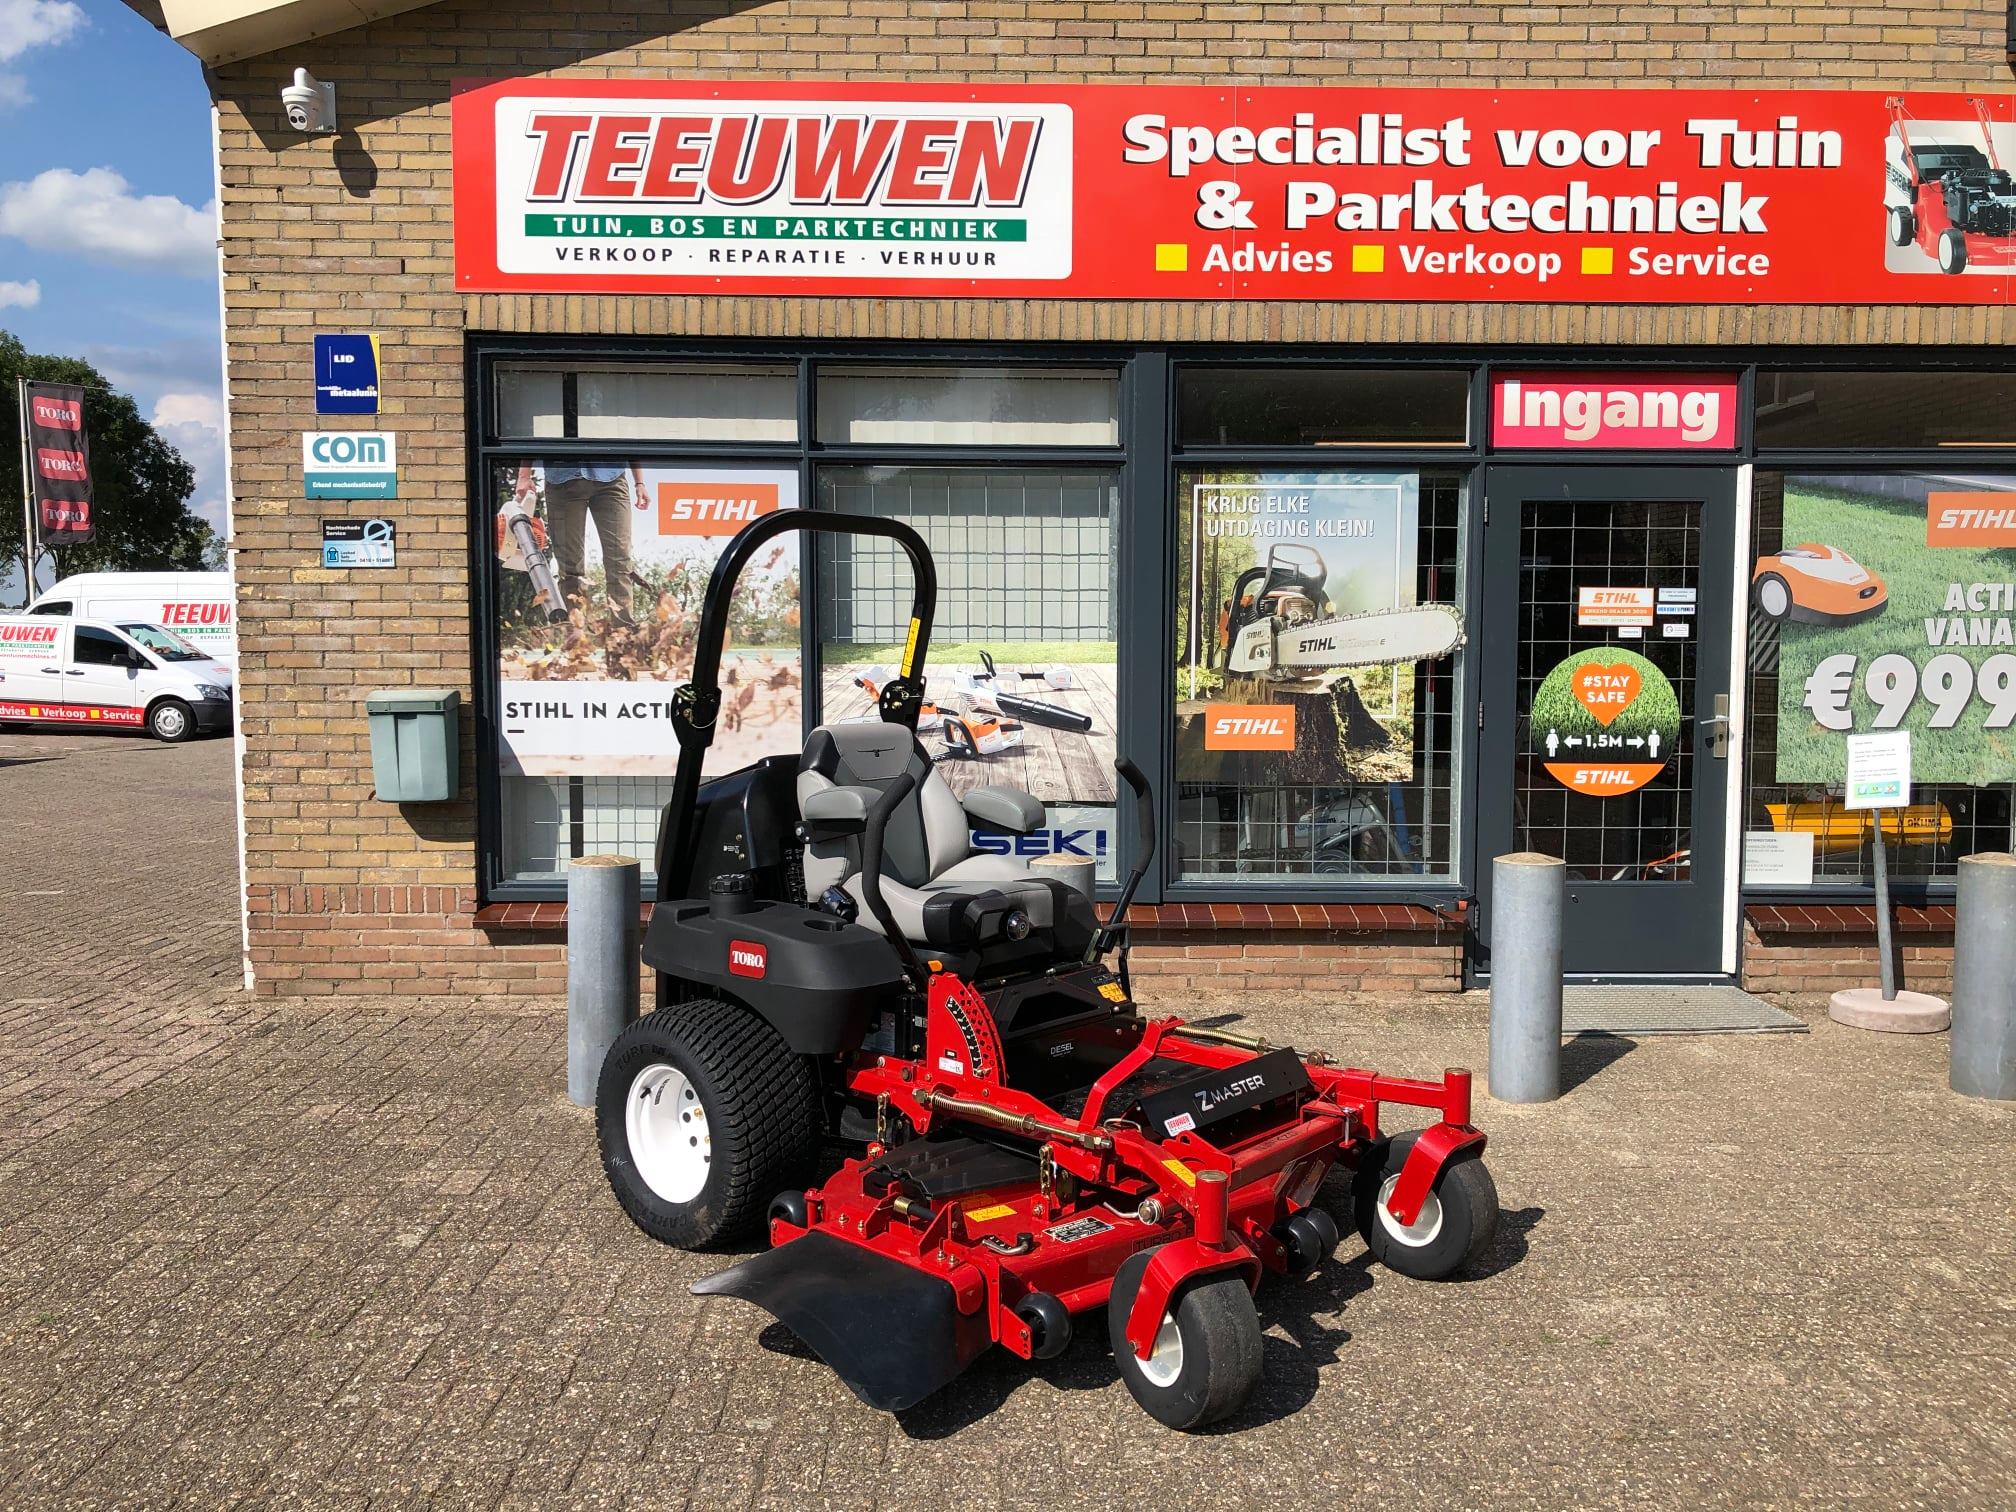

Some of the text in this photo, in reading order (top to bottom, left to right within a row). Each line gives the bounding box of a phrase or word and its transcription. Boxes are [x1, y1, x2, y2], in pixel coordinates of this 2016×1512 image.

[1122, 113, 1843, 176] Specialist voor Tuin
[526, 111, 1043, 206] TEEUWEN
[1195, 179, 1769, 234] & Parktechniek
[553, 217, 998, 239] TUIN, BOS EN PARKTECHNIEK
[556, 247, 997, 266] VERKOOP REPARATIE VERHUUR
[1202, 241, 1769, 283] Advies Verkoop Service
[333, 354, 355, 363] LID
[37, 405, 77, 421] TORO
[1503, 380, 1719, 442] Ingang
[42, 457, 82, 472] TORO
[671, 499, 762, 521] STIHL
[1207, 496, 1310, 514] KRIJG ELKE
[46, 508, 86, 523] TORO
[1207, 519, 1376, 537] UITDAGING KLEIN!
[1593, 592, 1640, 604] STIHL
[1944, 583, 2016, 611] ACTI
[1924, 617, 2016, 645] VANA
[1299, 637, 1336, 653] STIHL
[1583, 676, 1630, 687] #STAY
[1586, 691, 1626, 703] SAFE
[1803, 653, 2016, 730] €999
[41, 707, 87, 719] Verkoop
[103, 710, 141, 721] Service
[506, 702, 671, 719] STIHL IN ACTI
[1213, 719, 1284, 735] STIHL
[1585, 734, 1623, 749] 1,5M
[1574, 769, 1635, 785] STIHL
[971, 829, 1106, 856] SEKI
[732, 950, 764, 968] TORO
[1210, 1074, 1266, 1104] MASTER
